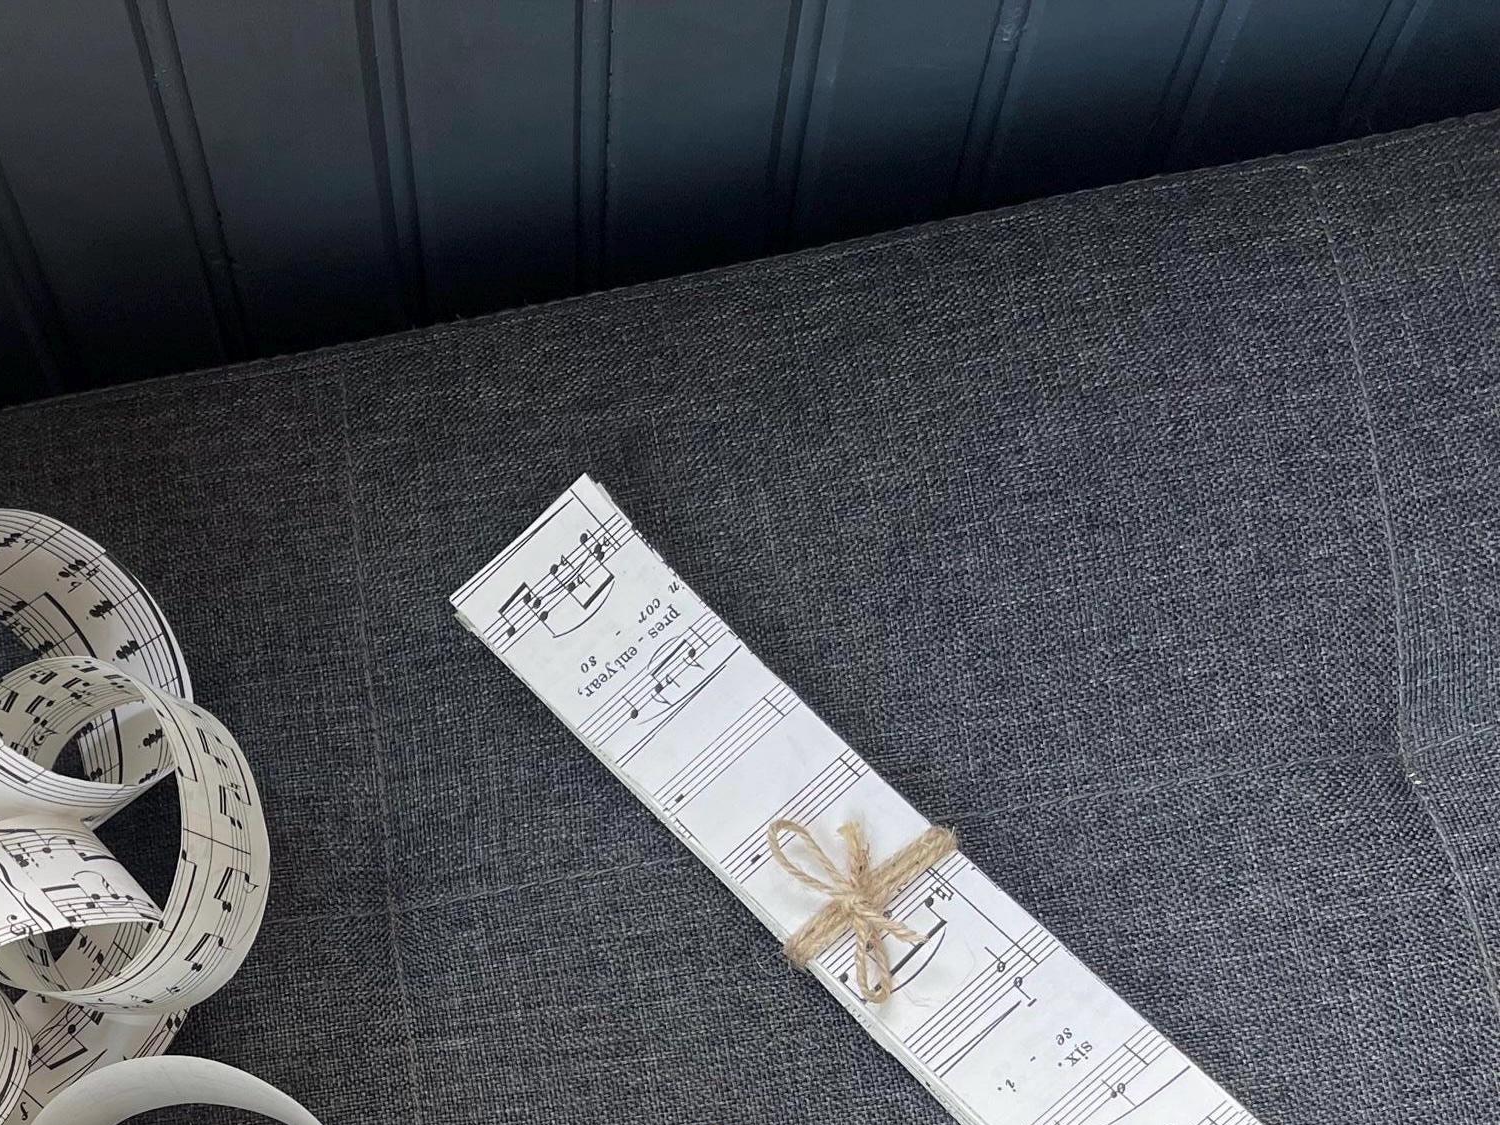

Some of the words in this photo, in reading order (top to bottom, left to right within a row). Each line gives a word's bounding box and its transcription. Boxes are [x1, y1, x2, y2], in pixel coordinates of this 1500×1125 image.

[638, 598, 661, 624] cor
[580, 655, 597, 673] so
[1054, 1027, 1073, 1046] se
